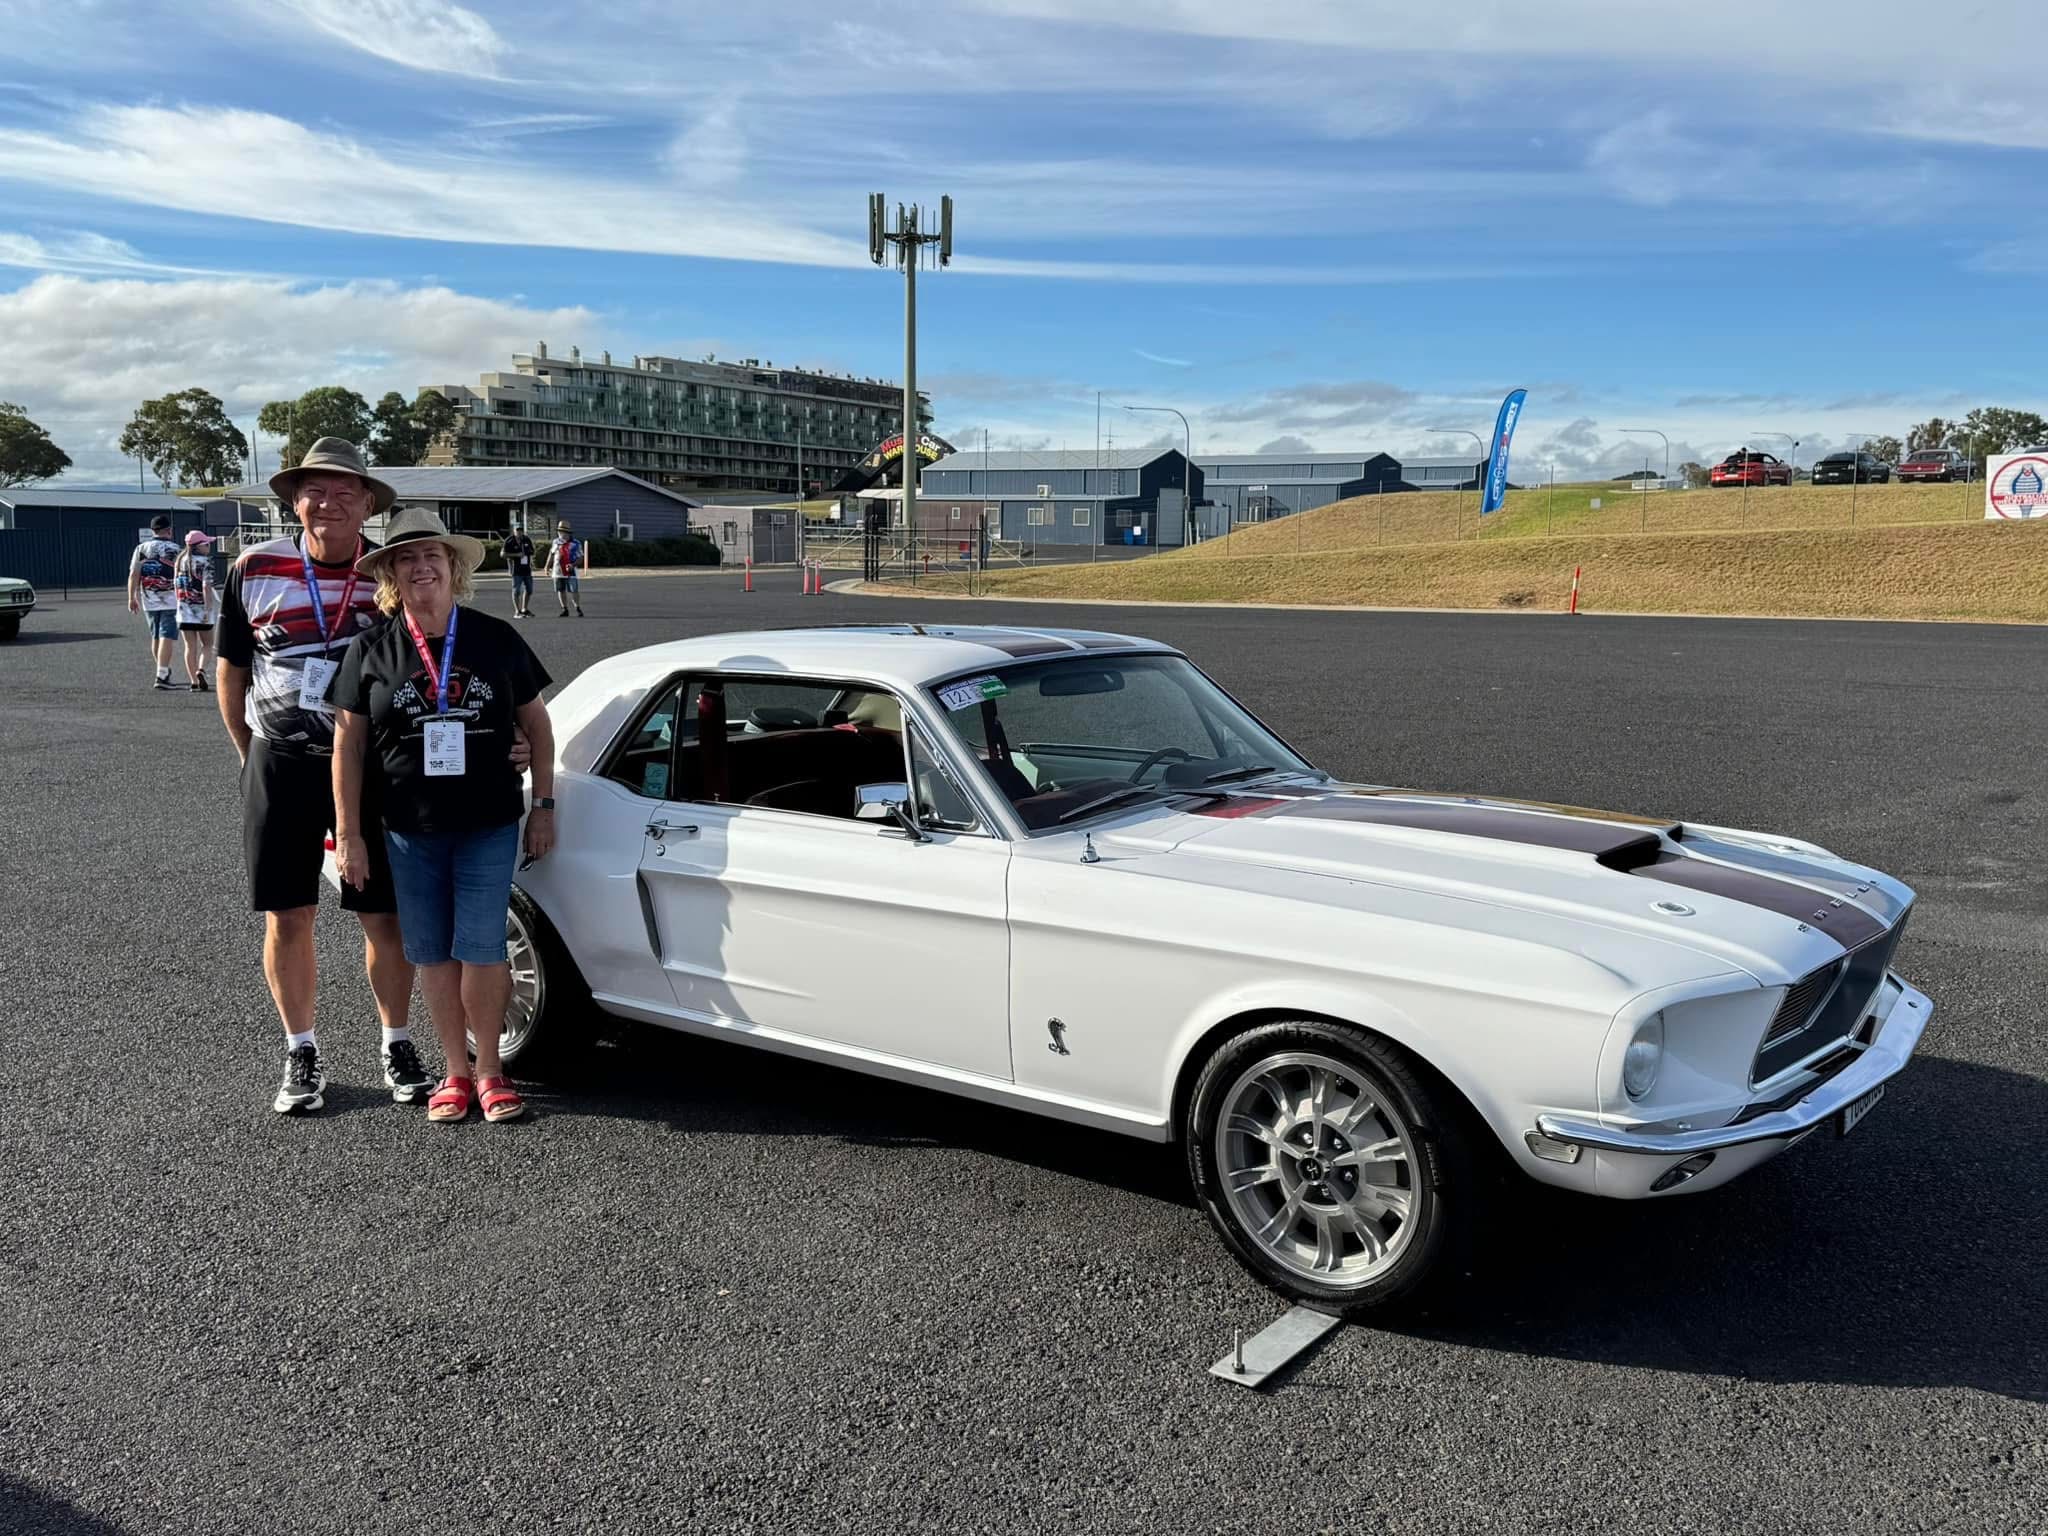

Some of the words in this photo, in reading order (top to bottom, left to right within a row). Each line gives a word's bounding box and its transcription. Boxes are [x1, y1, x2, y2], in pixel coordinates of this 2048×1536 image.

[883, 443, 938, 461] WAROUSE
[920, 435, 941, 452] Car
[946, 689, 972, 705] 121
